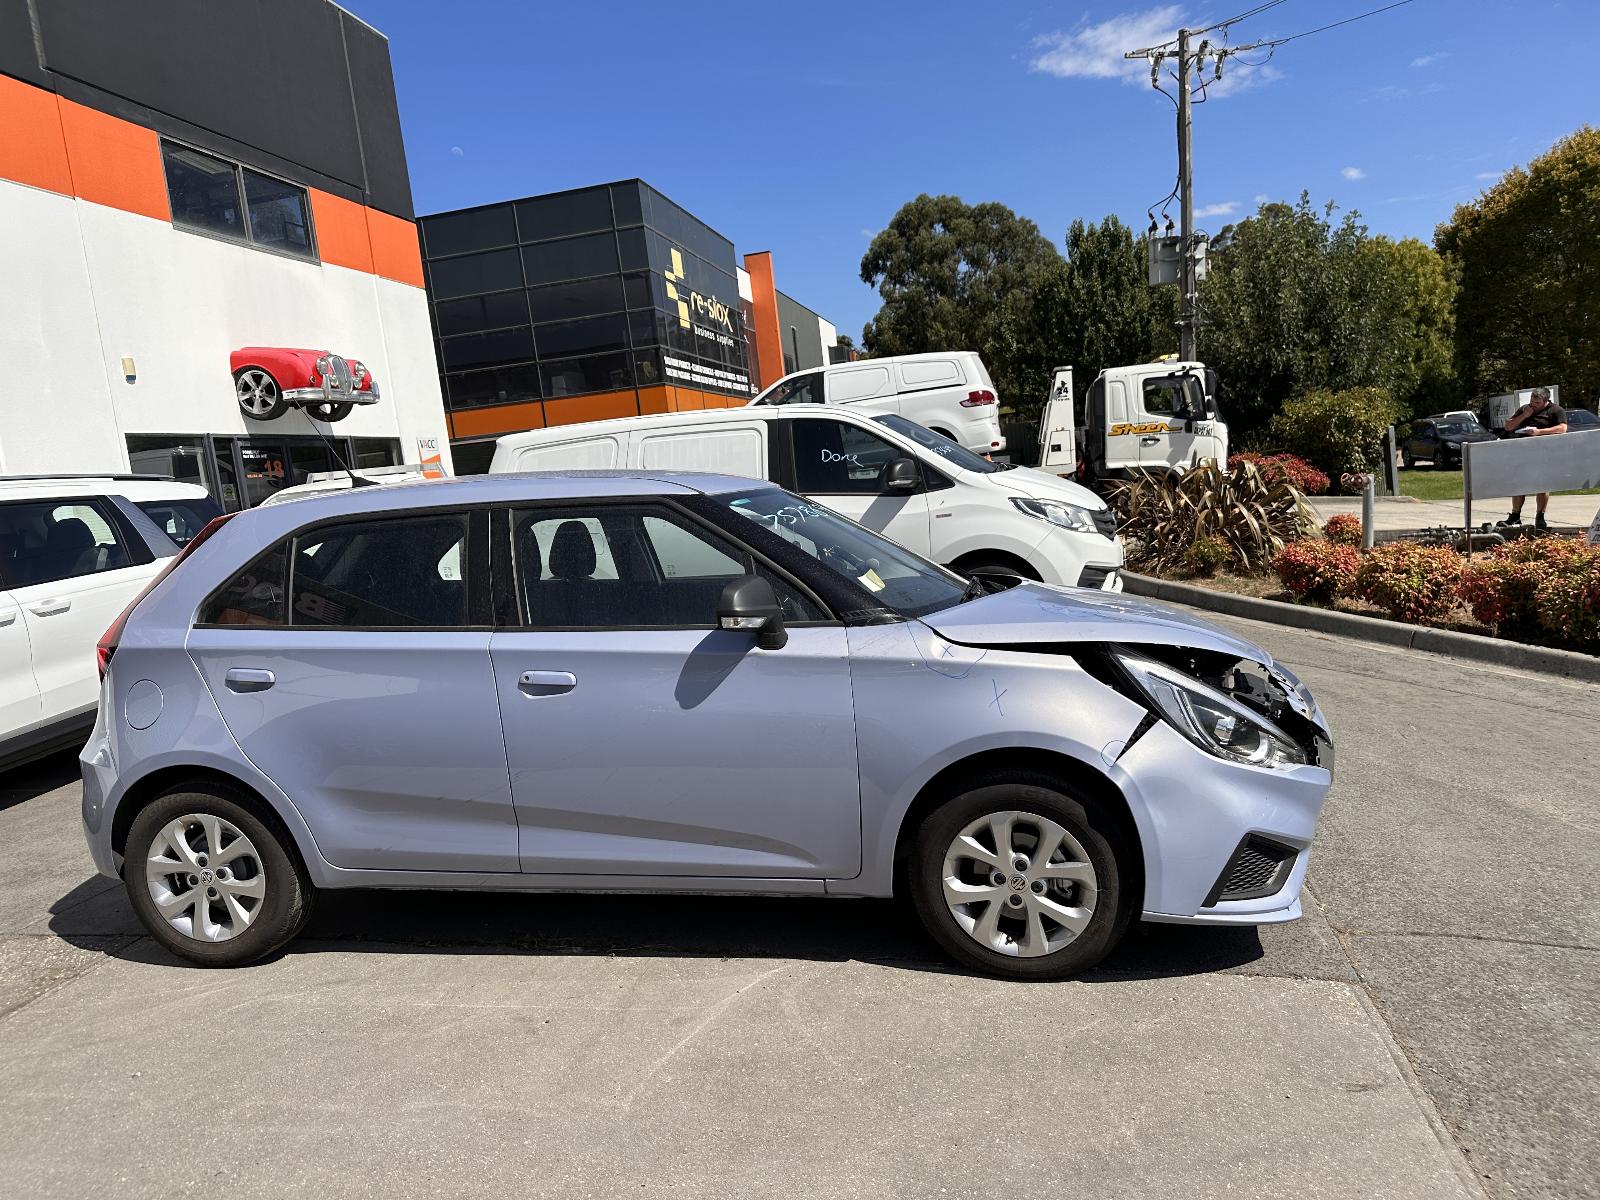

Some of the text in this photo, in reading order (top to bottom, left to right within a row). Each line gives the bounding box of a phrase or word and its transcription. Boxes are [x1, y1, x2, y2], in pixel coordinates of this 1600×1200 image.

[694, 324, 734, 348] business supplies
[821, 449, 864, 467] Done
